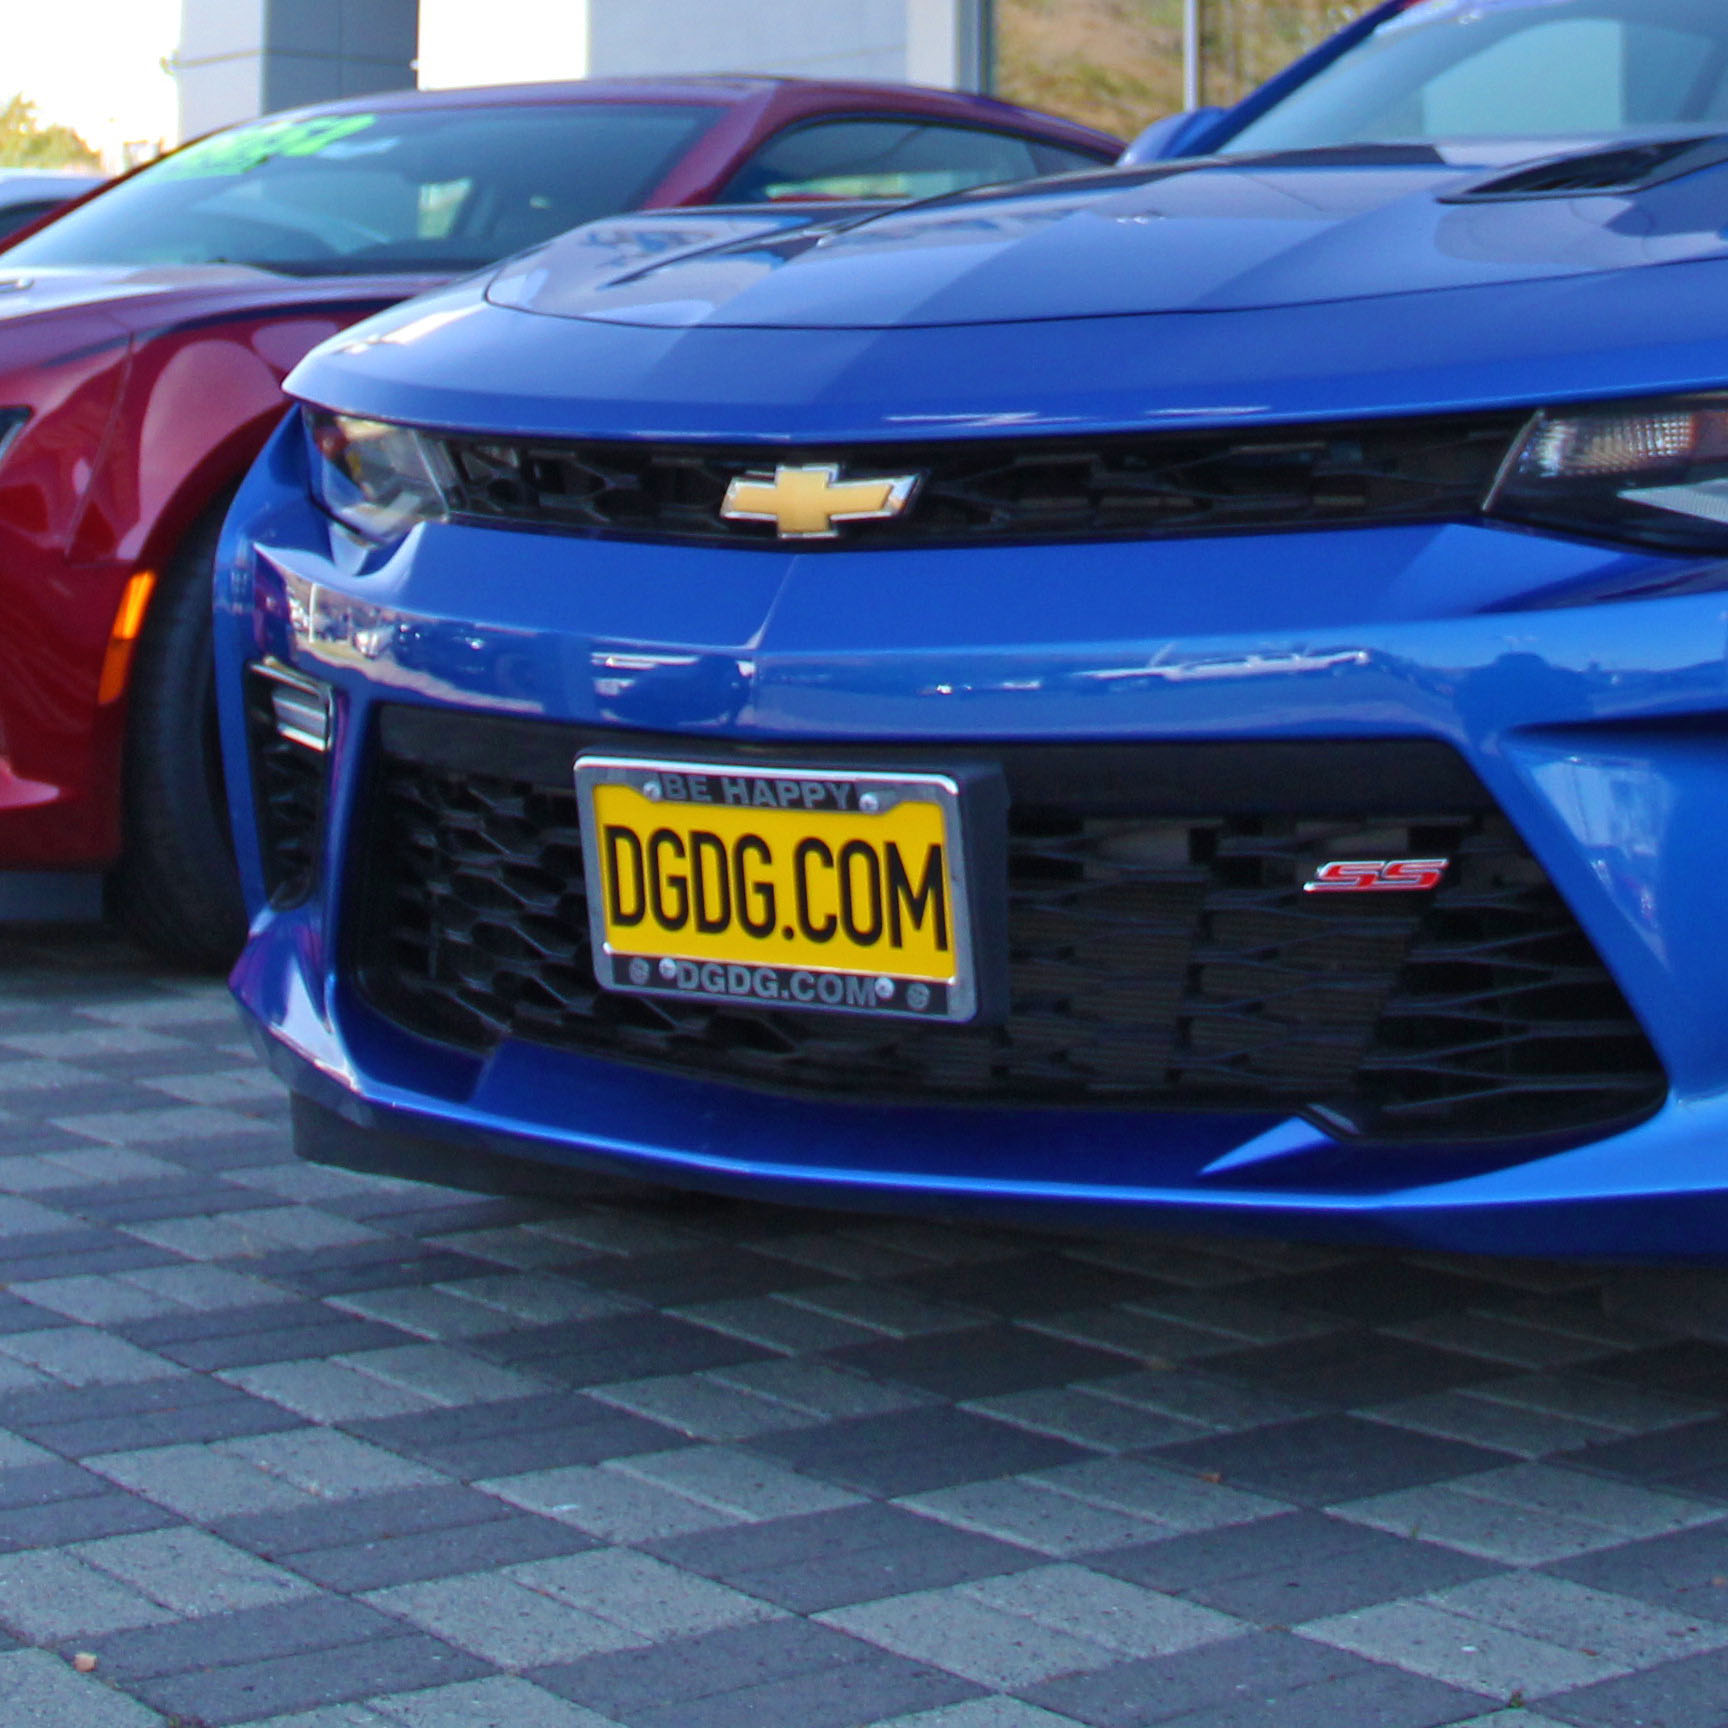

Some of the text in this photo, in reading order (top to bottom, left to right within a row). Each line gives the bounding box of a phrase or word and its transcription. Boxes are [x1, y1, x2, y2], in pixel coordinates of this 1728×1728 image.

[661, 772, 852, 810] BE HAPPY
[604, 824, 949, 951] DGDG.COM
[1303, 858, 1449, 893] SS
[675, 959, 878, 1007] DGDG.COM
